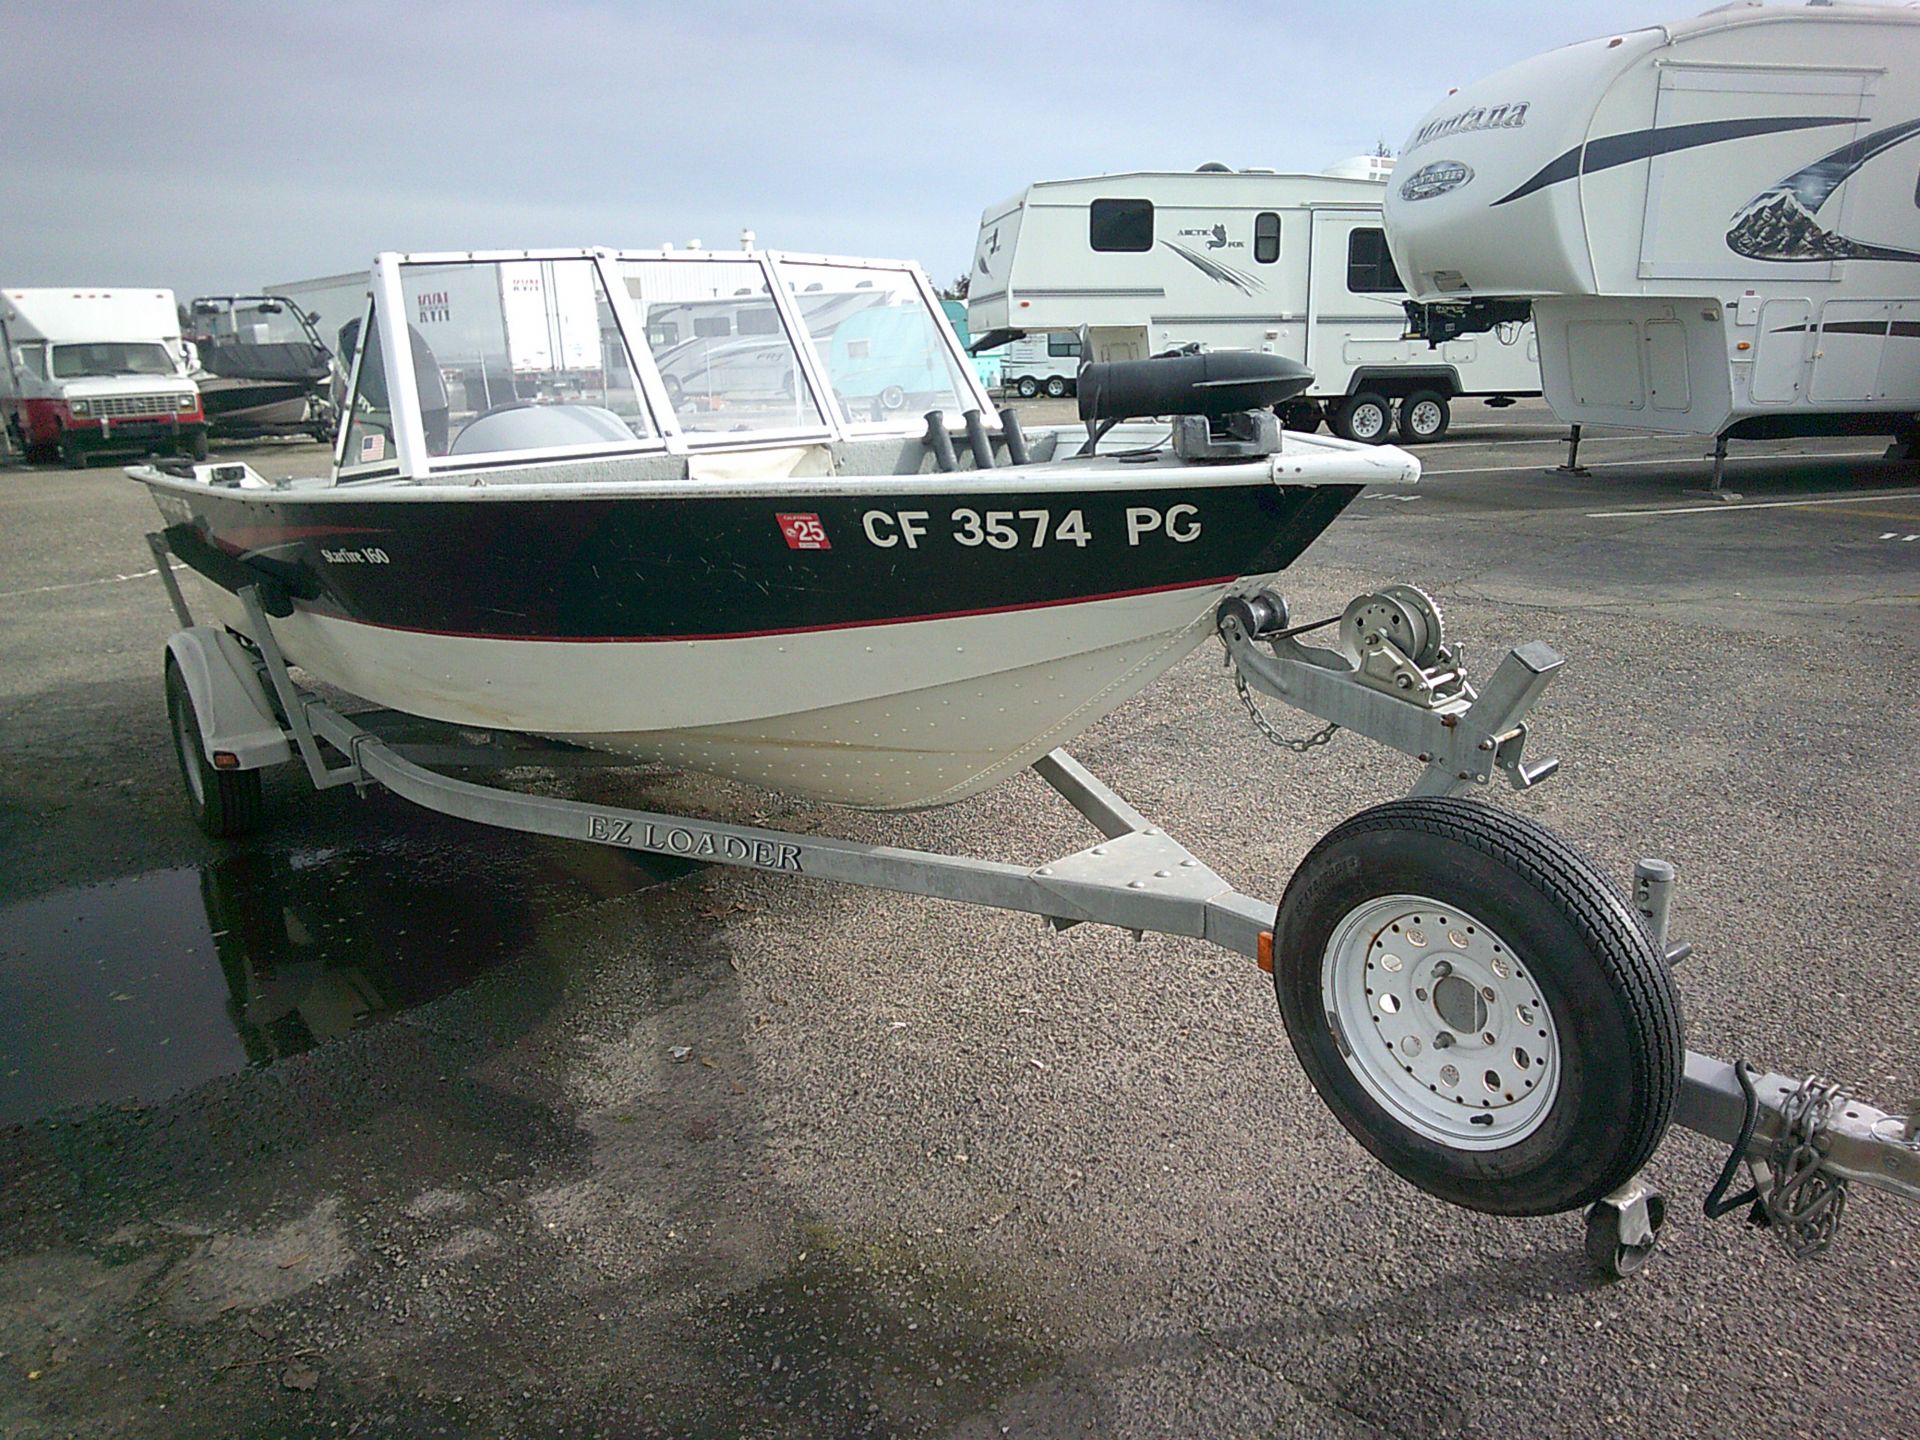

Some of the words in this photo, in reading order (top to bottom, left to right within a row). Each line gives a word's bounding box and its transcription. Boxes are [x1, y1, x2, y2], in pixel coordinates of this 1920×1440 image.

[1406, 101, 1530, 155] Montana
[1177, 229, 1211, 237] ARCTIC
[794, 521, 825, 541] 25
[862, 510, 930, 549] CF
[951, 508, 1092, 549] 3574
[1125, 504, 1201, 546] PG
[361, 548, 390, 564] 160
[587, 815, 632, 844] EZ
[645, 824, 804, 872] LOADER
